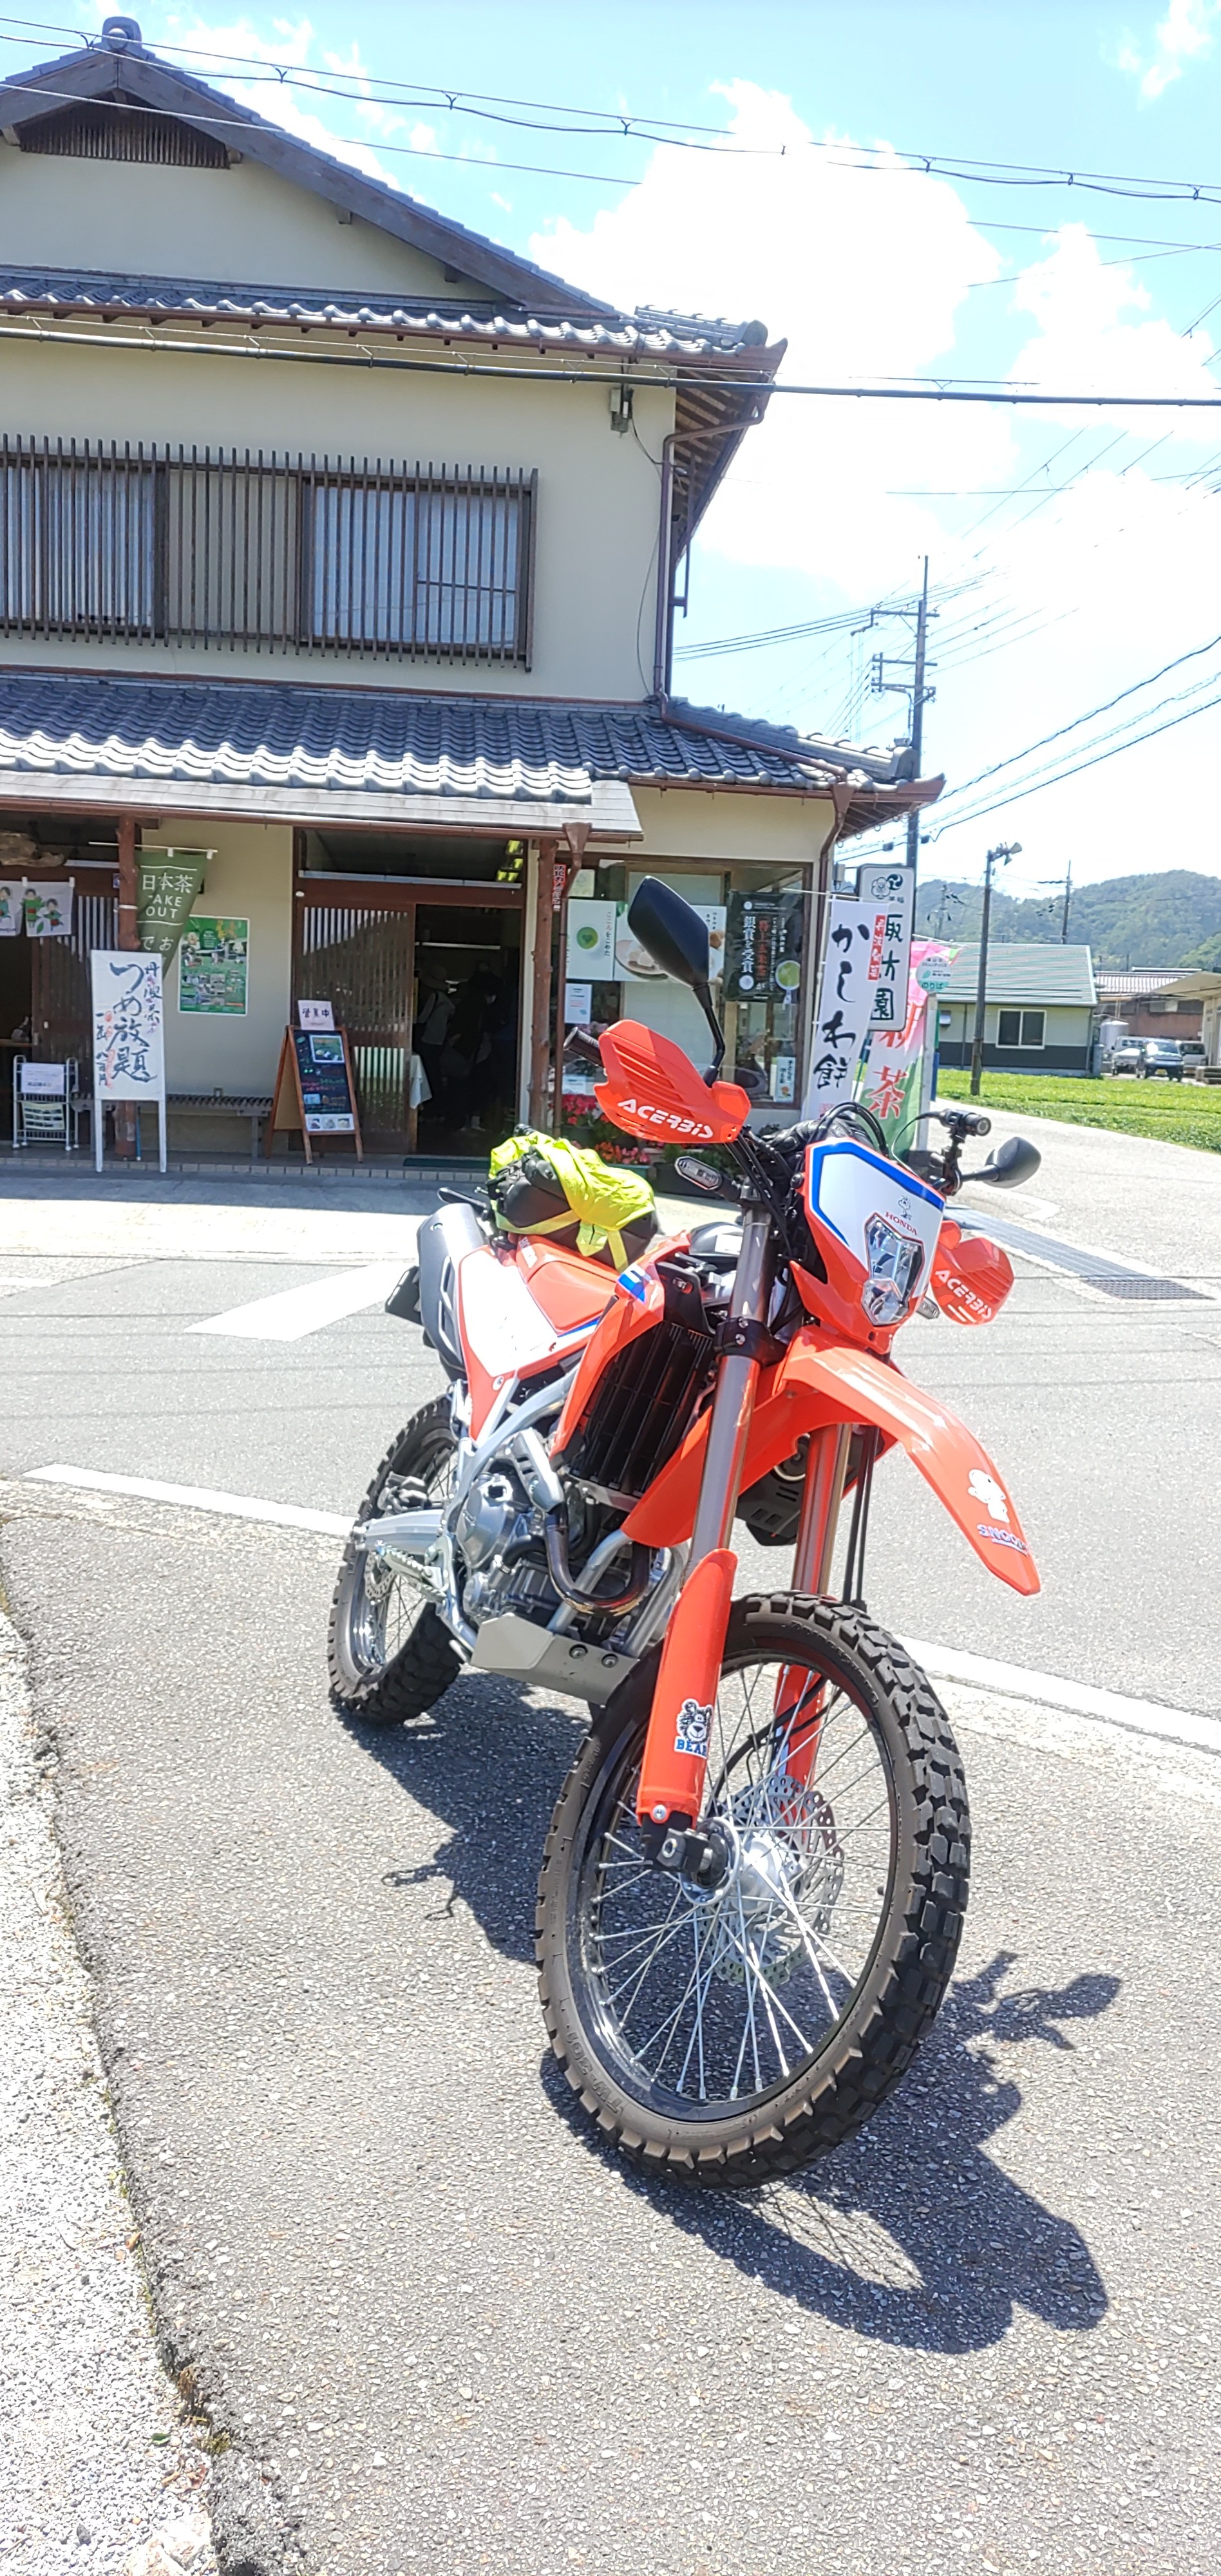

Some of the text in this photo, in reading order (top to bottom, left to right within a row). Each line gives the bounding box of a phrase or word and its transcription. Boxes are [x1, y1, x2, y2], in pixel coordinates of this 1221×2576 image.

[142, 873, 193, 894] 日本茶
[146, 906, 178, 918] OUT
[741, 916, 756, 973] 銀賞を受賞
[922, 981, 943, 990] のりば
[105, 962, 158, 1083] つめ放題
[813, 923, 870, 1090] かしわ餅
[617, 1098, 714, 1139] ACERBIS
[885, 1211, 918, 1236] HONDA
[934, 1269, 992, 1319] ACERBIS
